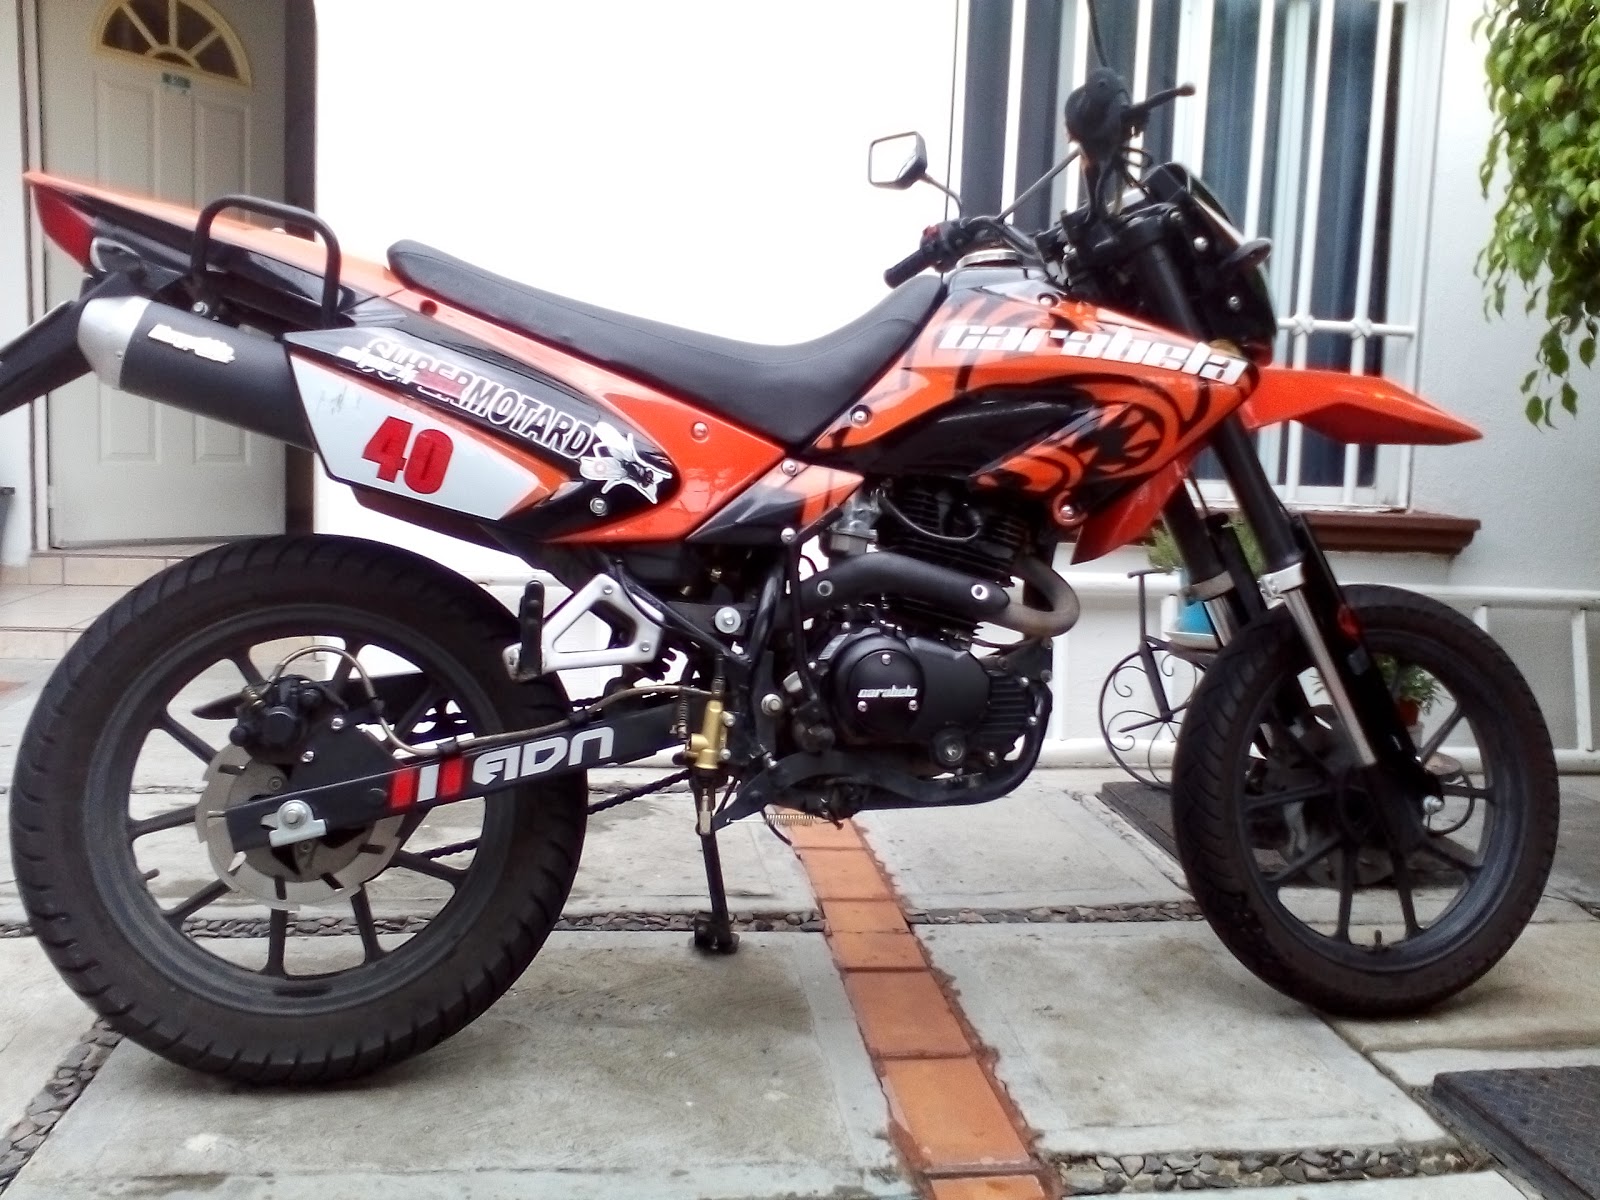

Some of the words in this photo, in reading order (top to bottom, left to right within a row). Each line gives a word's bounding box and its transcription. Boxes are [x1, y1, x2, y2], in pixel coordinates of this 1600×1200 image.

[938, 324, 1248, 385] carabela
[360, 337, 594, 459] SUPERMOTARD
[361, 415, 454, 494] 40
[472, 726, 615, 785] ADN
